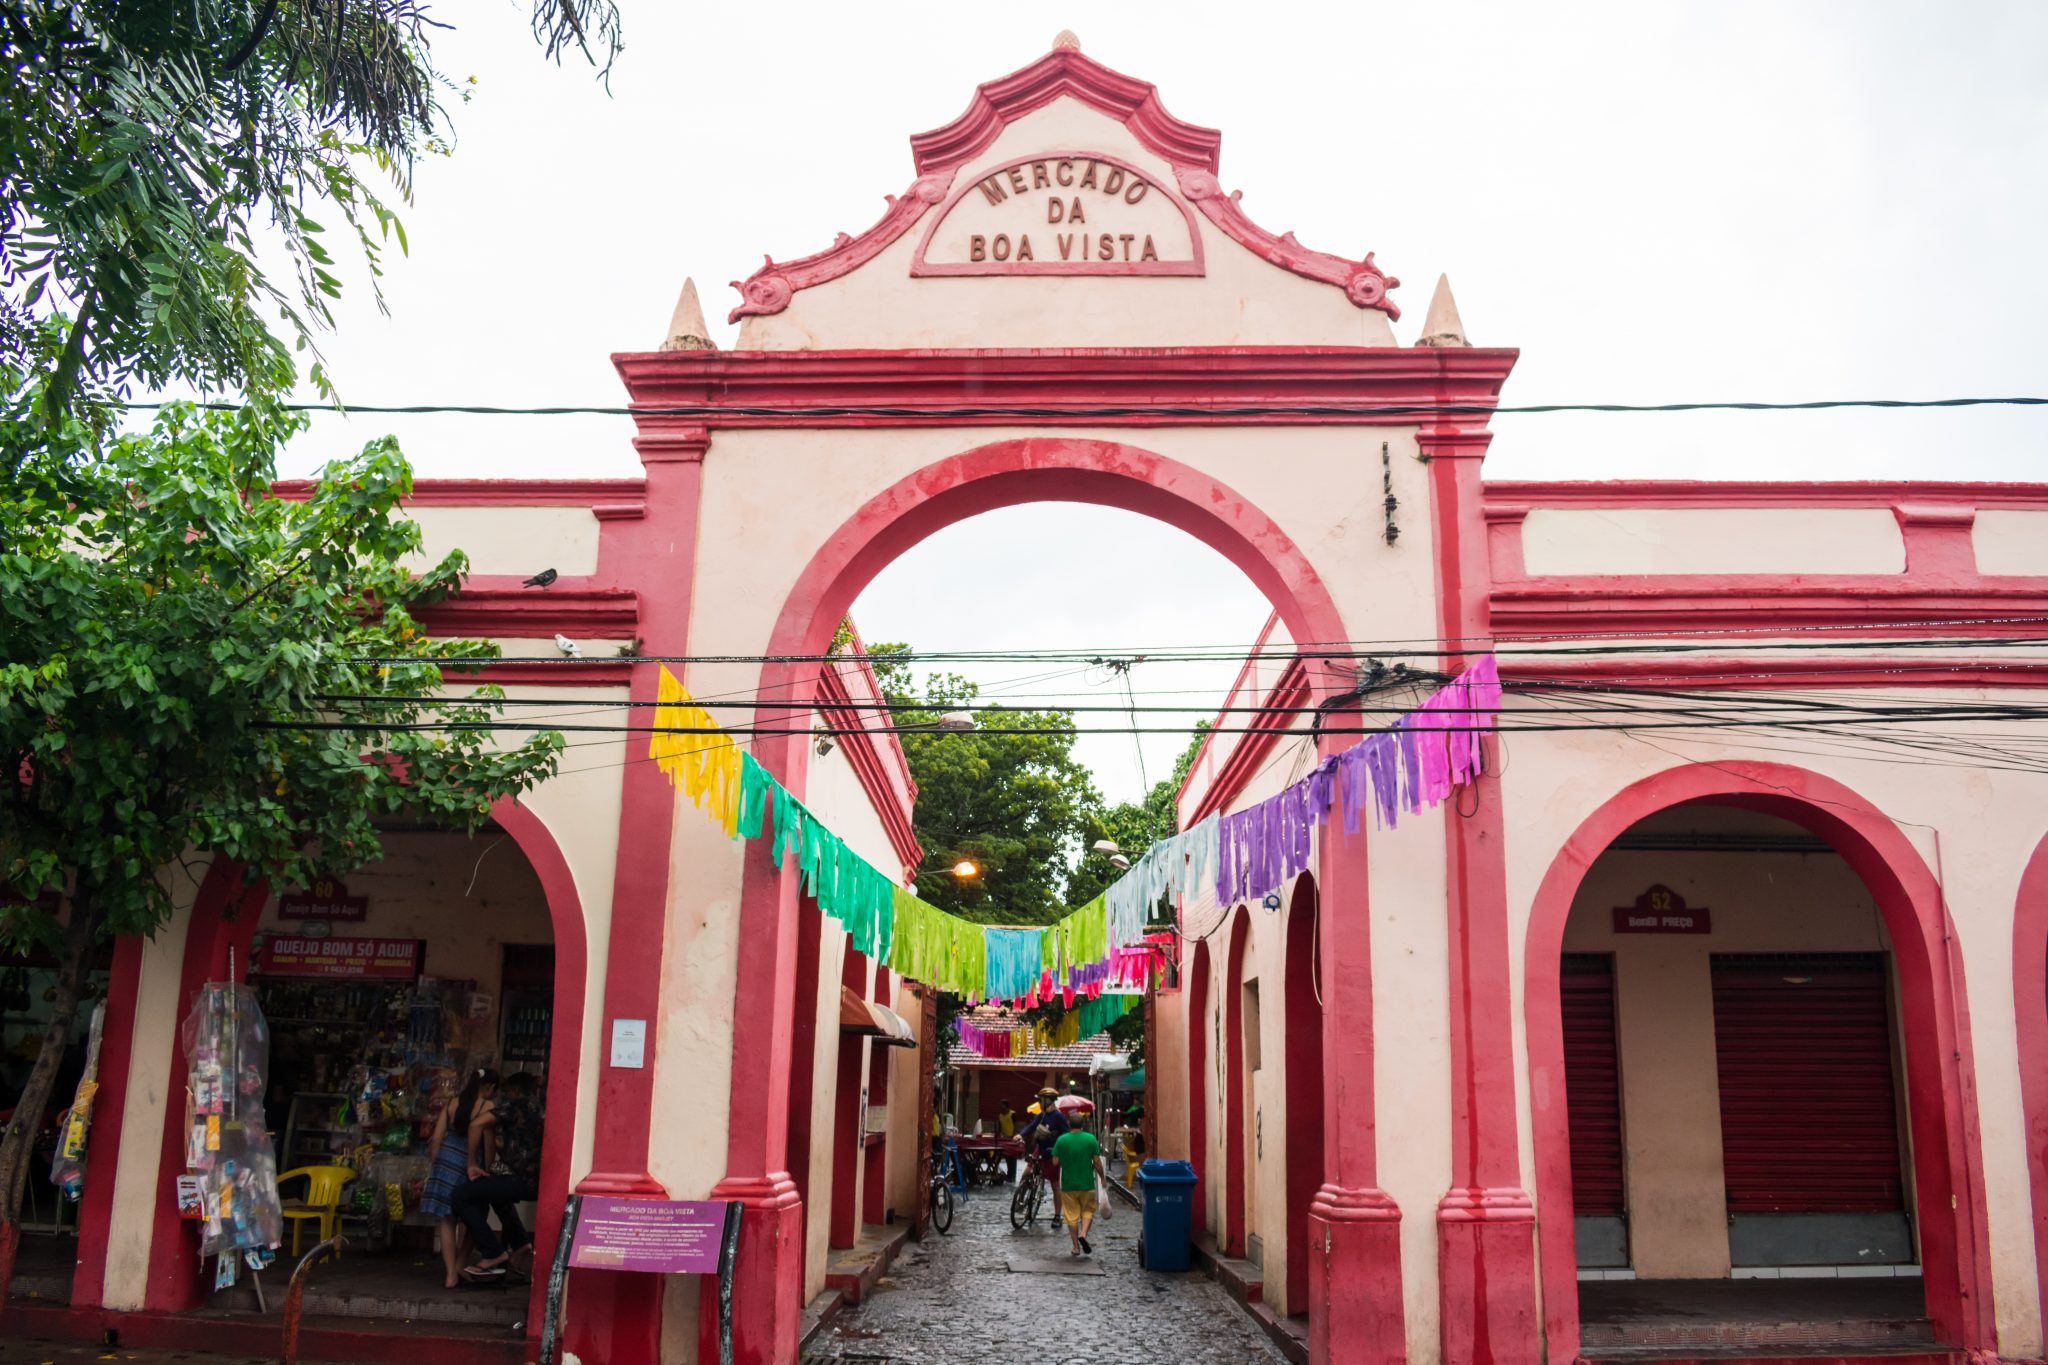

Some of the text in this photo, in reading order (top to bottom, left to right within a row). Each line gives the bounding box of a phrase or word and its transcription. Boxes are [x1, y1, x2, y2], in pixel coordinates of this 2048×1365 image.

[976, 157, 1149, 206] MERCADO
[1048, 196, 1085, 224] DA
[970, 233, 1158, 262] BOA VISTA
[315, 881, 334, 898] 60
[312, 904, 329, 914] Bom
[1651, 892, 1671, 910] 52
[274, 939, 414, 958] QUEIJO BOM SÓ AQUI!
[610, 1206, 646, 1214] MERCADO
[647, 1207, 657, 1215] DA
